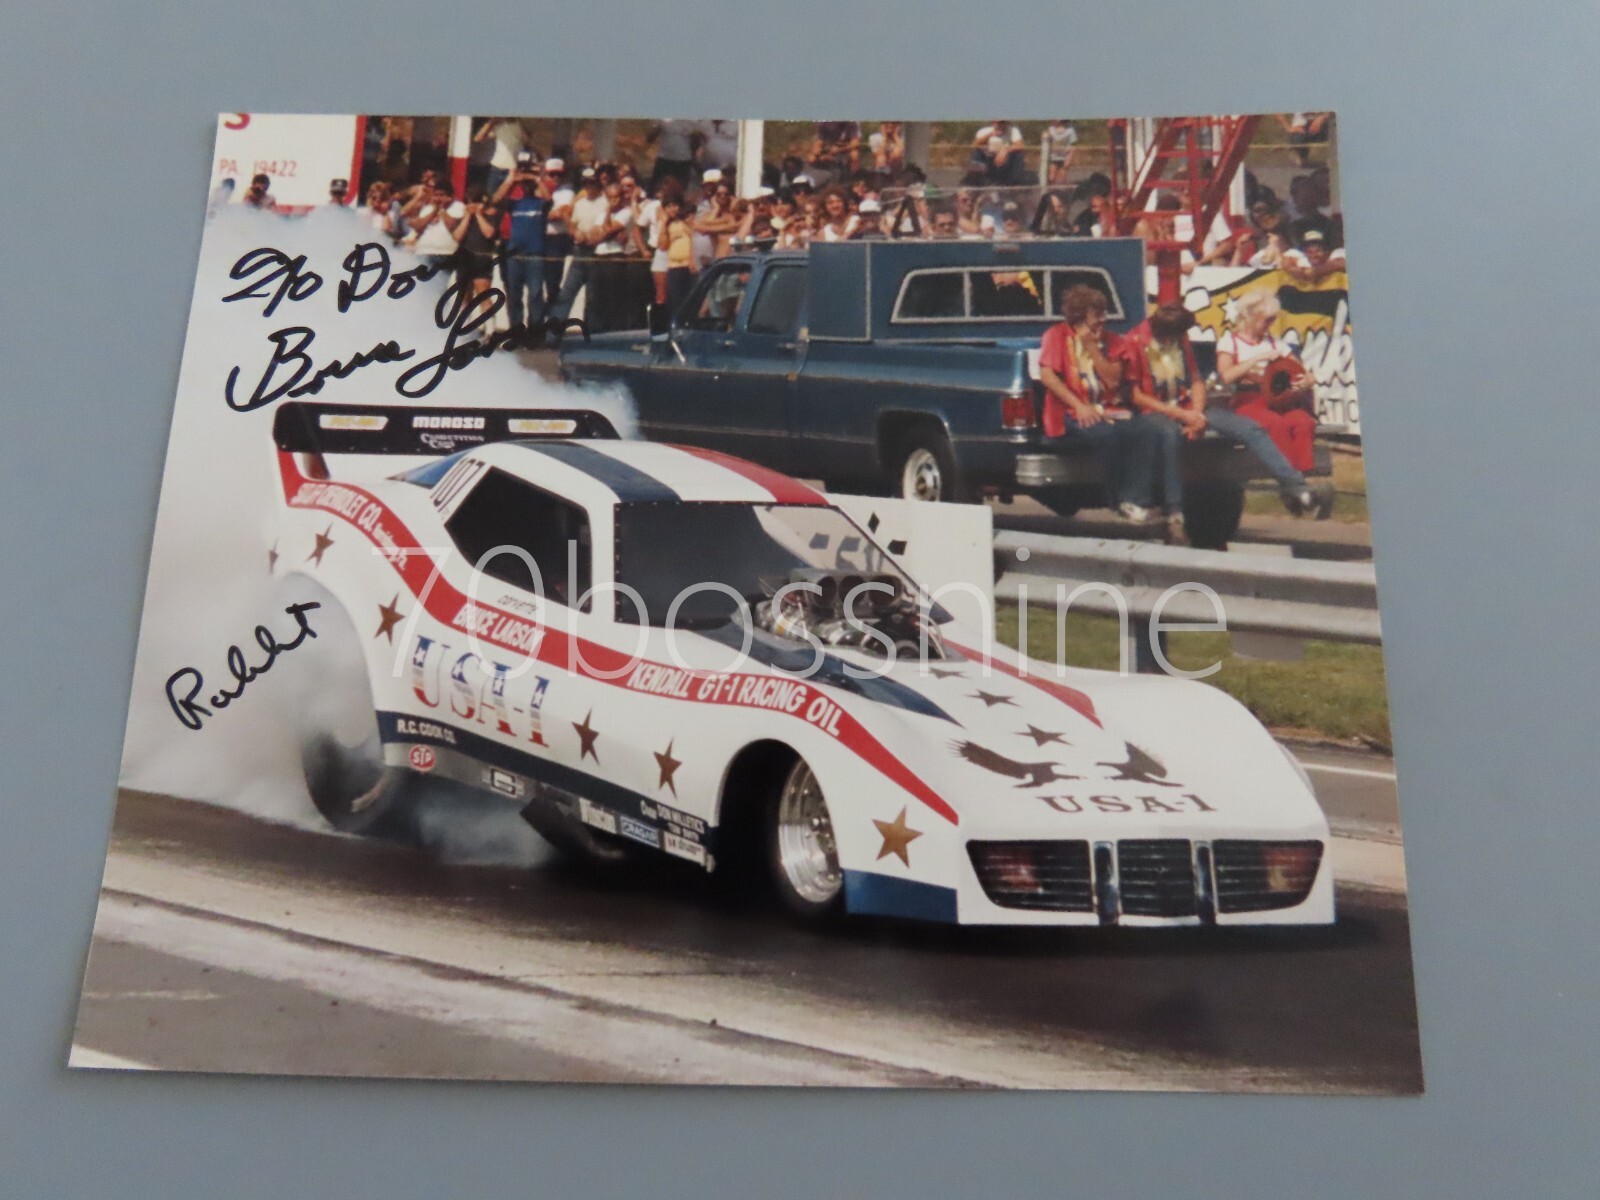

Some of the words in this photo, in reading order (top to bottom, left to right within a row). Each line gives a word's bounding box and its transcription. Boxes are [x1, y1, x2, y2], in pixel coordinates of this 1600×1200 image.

[253, 160, 297, 177] 19422
[225, 327, 415, 411] Bruce
[396, 288, 591, 398] Larson
[412, 416, 486, 430] MOROSO
[453, 604, 500, 638] BRUCE
[490, 615, 545, 652] LARSON
[412, 634, 549, 748] USA-1
[626, 660, 696, 698] KENDALL
[697, 674, 740, 703] GT-1
[738, 676, 806, 712] RACING
[805, 696, 842, 737] OIL
[413, 748, 433, 764] STP
[1035, 794, 1217, 813] USA-1
